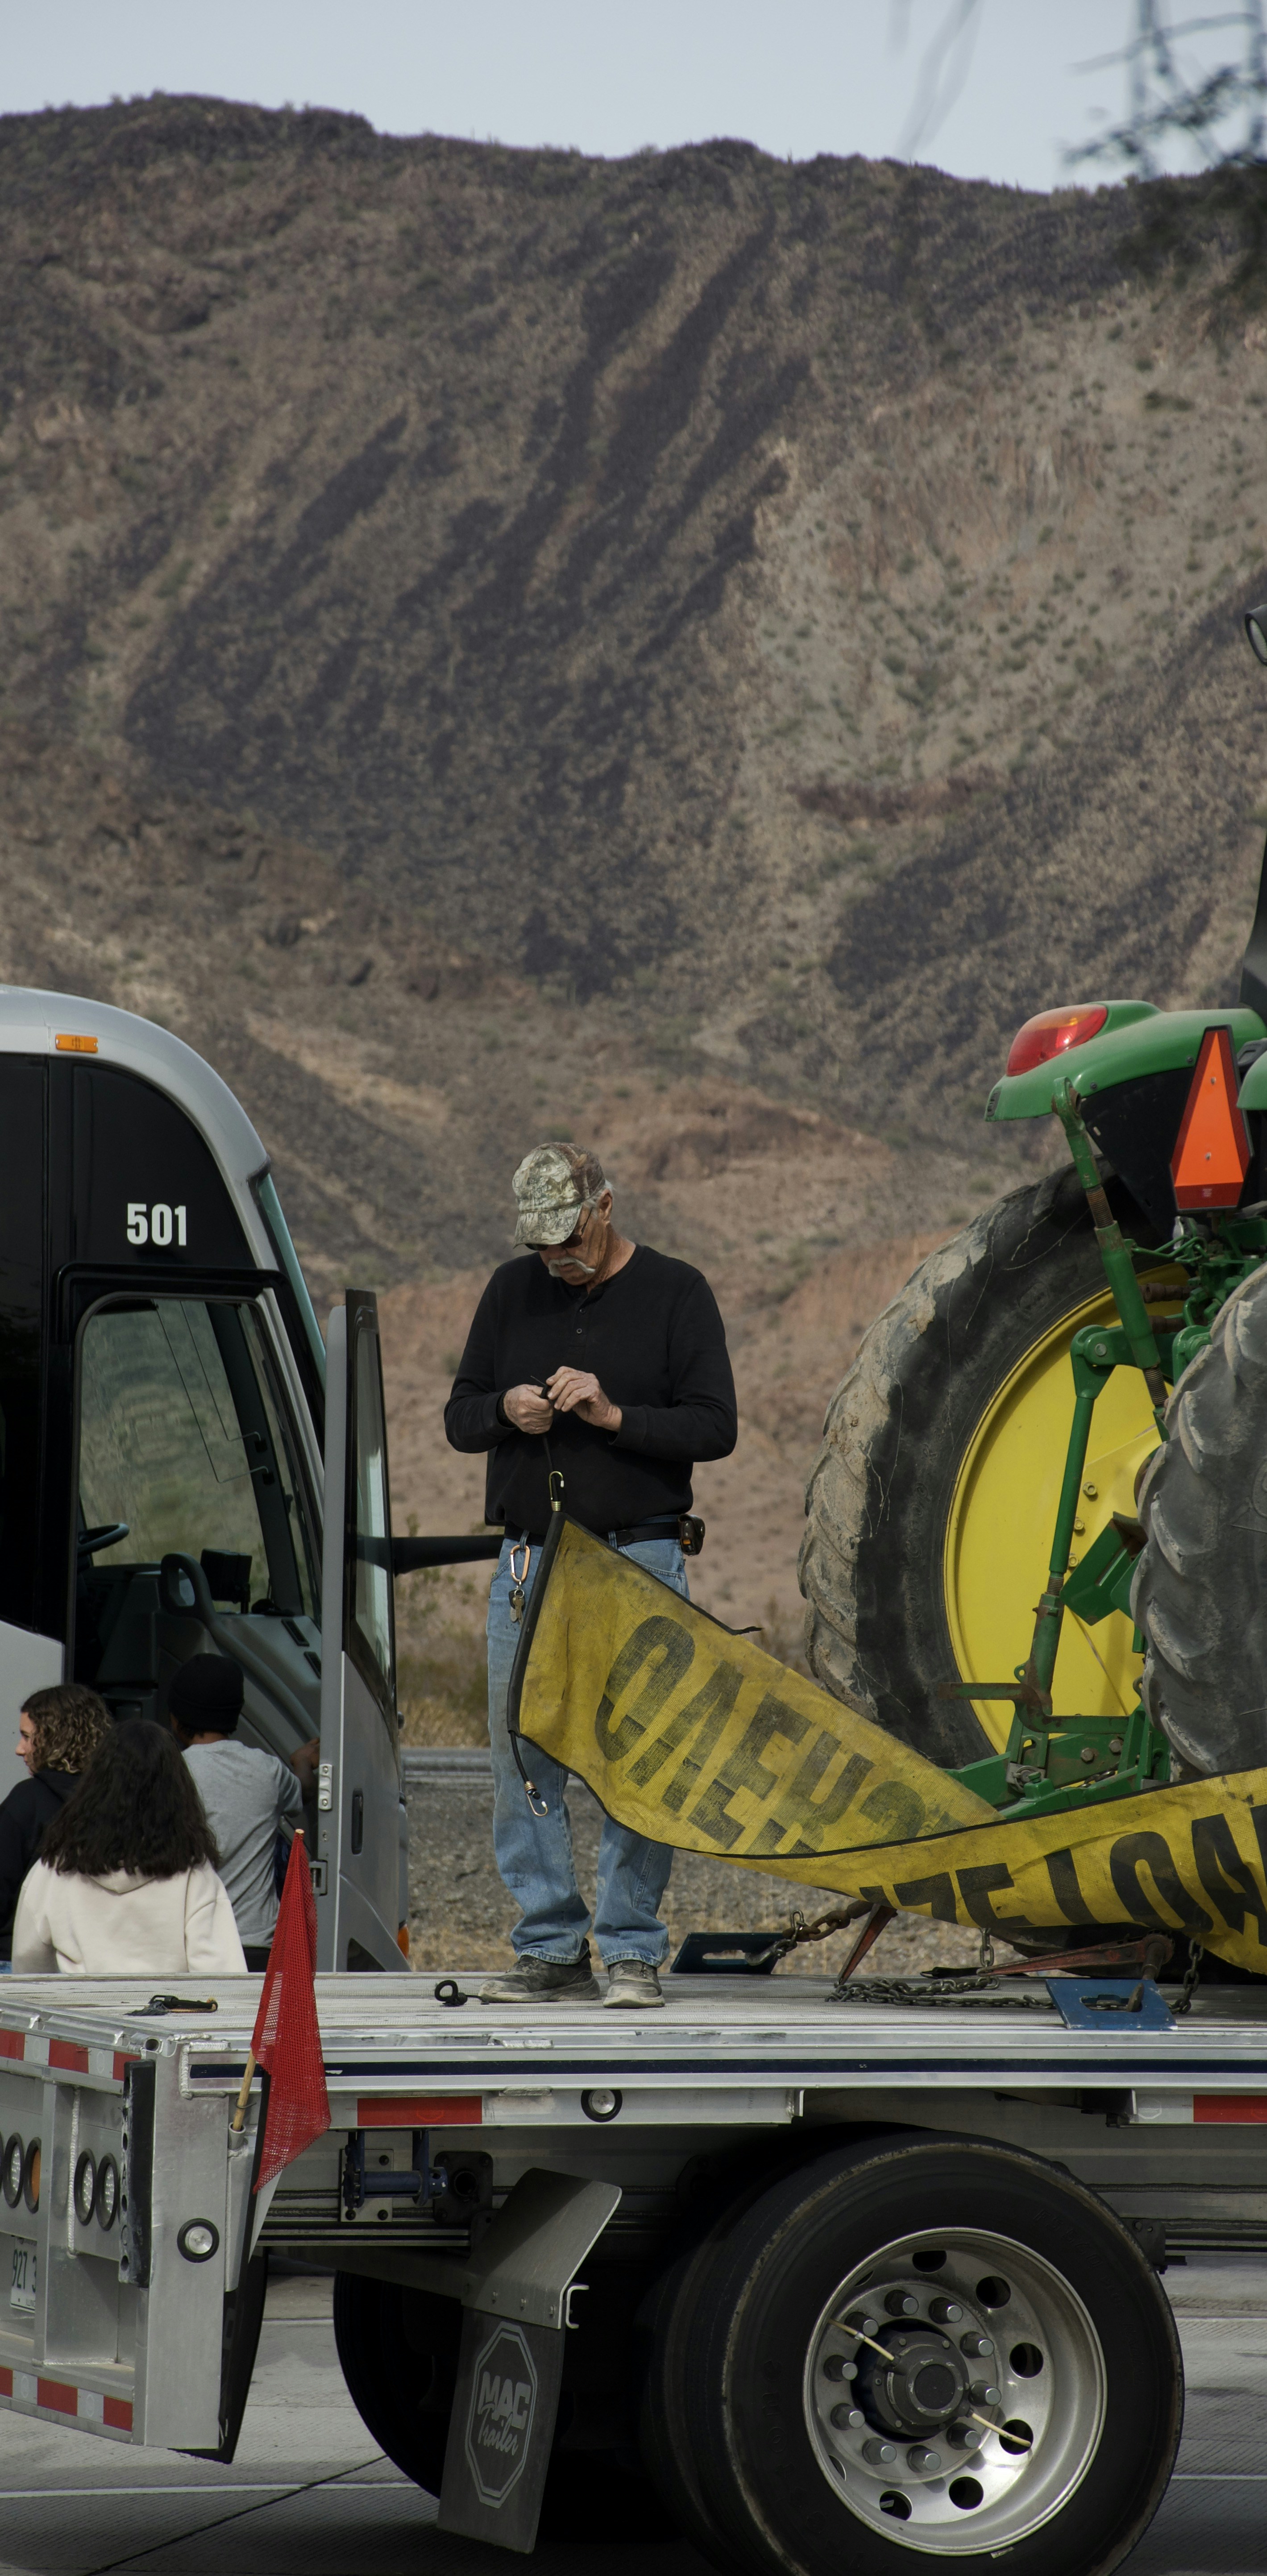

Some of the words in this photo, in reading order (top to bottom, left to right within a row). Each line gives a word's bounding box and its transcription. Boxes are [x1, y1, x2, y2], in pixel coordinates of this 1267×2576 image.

[127, 1203, 187, 1246] 501
[12, 2248, 28, 2289] 927
[478, 2371, 531, 2430] MAC
[478, 2403, 519, 2456] Trailer
